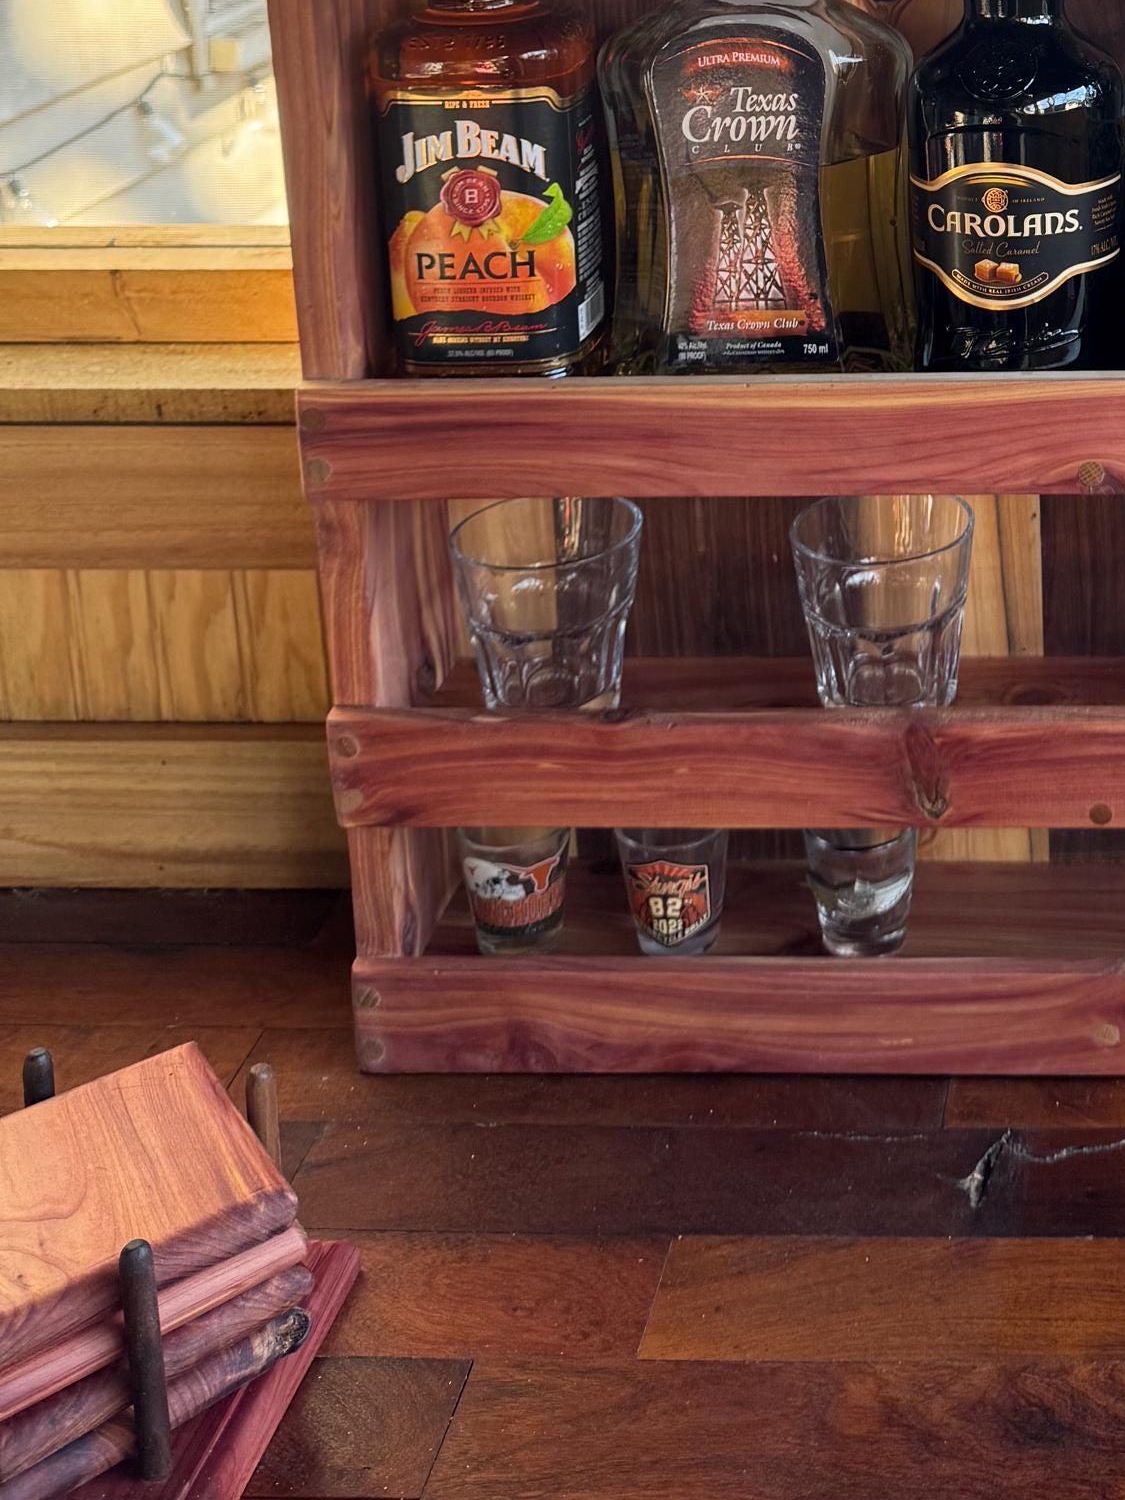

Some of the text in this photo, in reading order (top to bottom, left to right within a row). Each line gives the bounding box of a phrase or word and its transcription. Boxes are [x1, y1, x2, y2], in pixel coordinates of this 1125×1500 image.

[697, 51, 781, 67] ULTRA PREMIUM
[730, 86, 799, 113] Texas
[682, 105, 799, 143] Crown
[395, 119, 547, 184] JIM BEAM
[927, 203, 1080, 238] CAROLANS
[961, 239, 1041, 258] Salted Caramel
[416, 250, 537, 280] PEACH
[956, 273, 971, 287] MADE
[988, 287, 1003, 295] REAL
[1023, 276, 1043, 290] CREAM
[706, 317, 800, 331] Texas Crown Club
[725, 341, 782, 350] Product of Canada
[803, 344, 818, 354] 750
